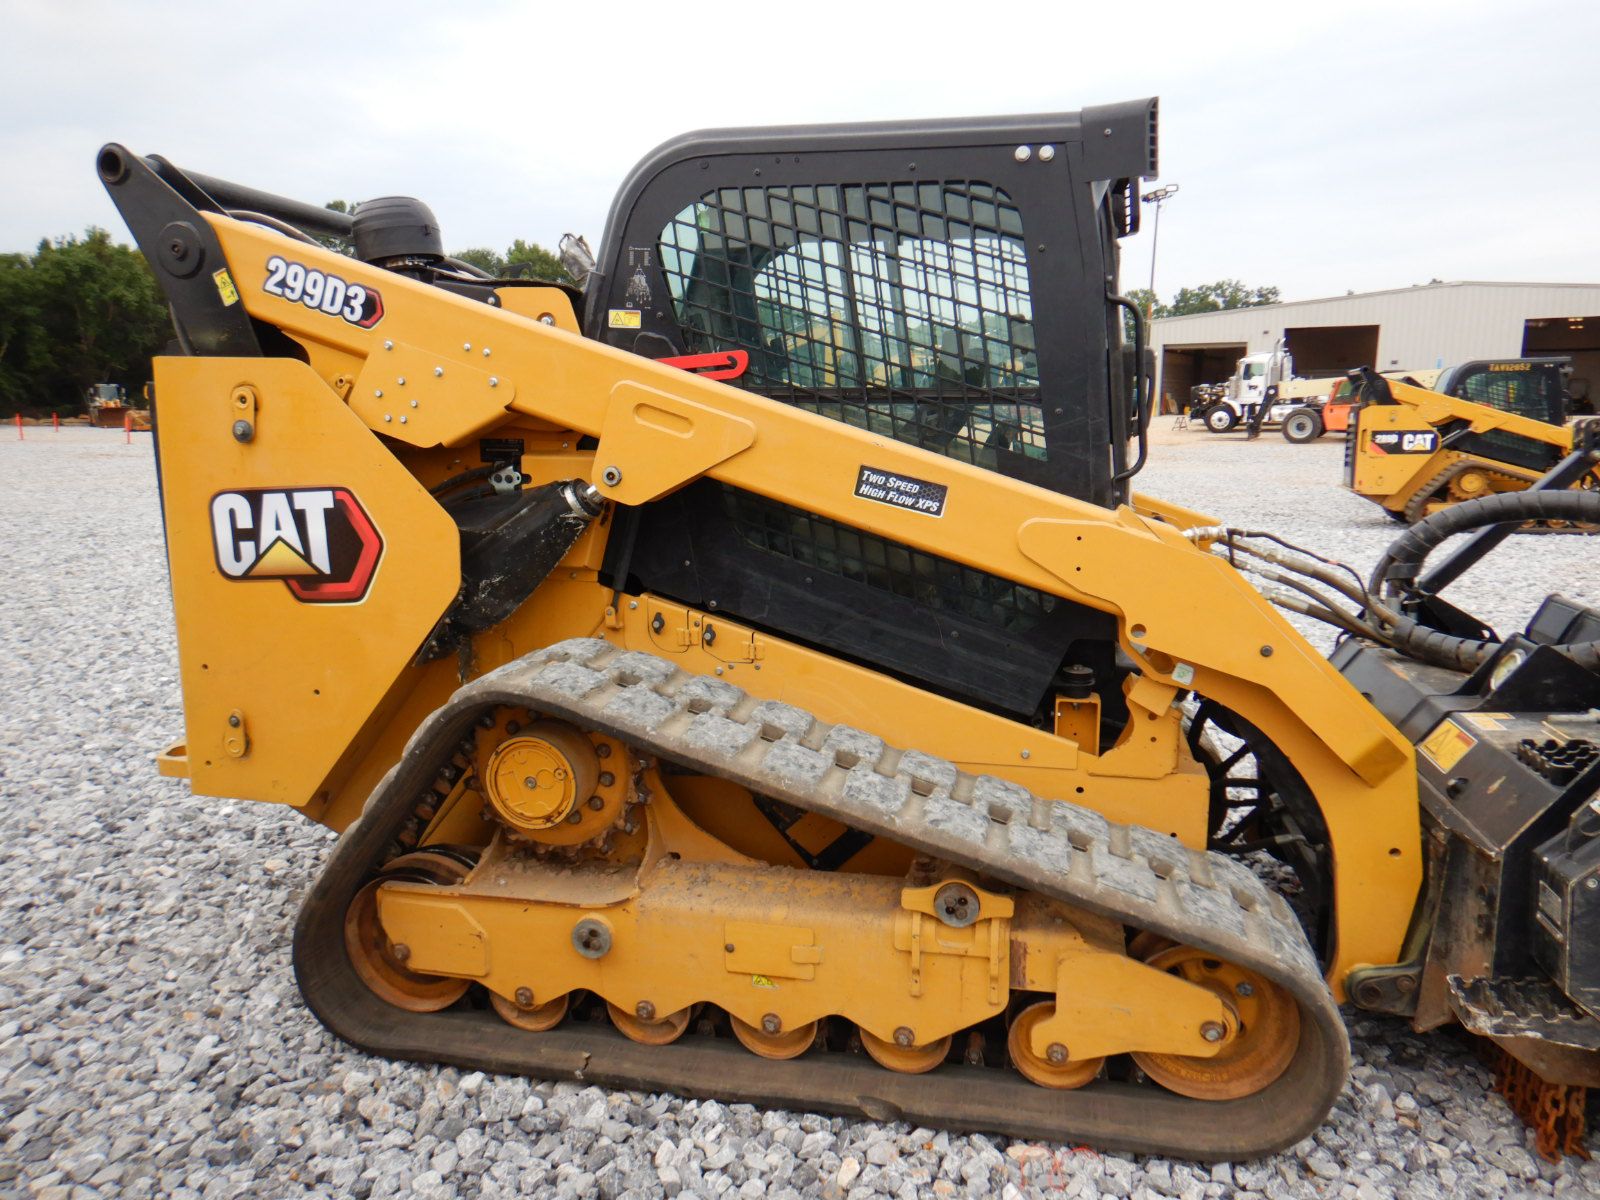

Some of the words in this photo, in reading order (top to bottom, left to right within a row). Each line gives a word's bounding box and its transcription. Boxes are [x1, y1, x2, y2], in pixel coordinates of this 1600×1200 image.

[263, 256, 367, 322] 299D3
[1402, 433, 1434, 451] CAT
[861, 470, 886, 485] TWO
[886, 476, 920, 494] SPEED
[858, 483, 886, 500] HIGH
[886, 490, 916, 507] FLOW
[914, 497, 940, 512] XPS
[211, 490, 335, 577] CAT
